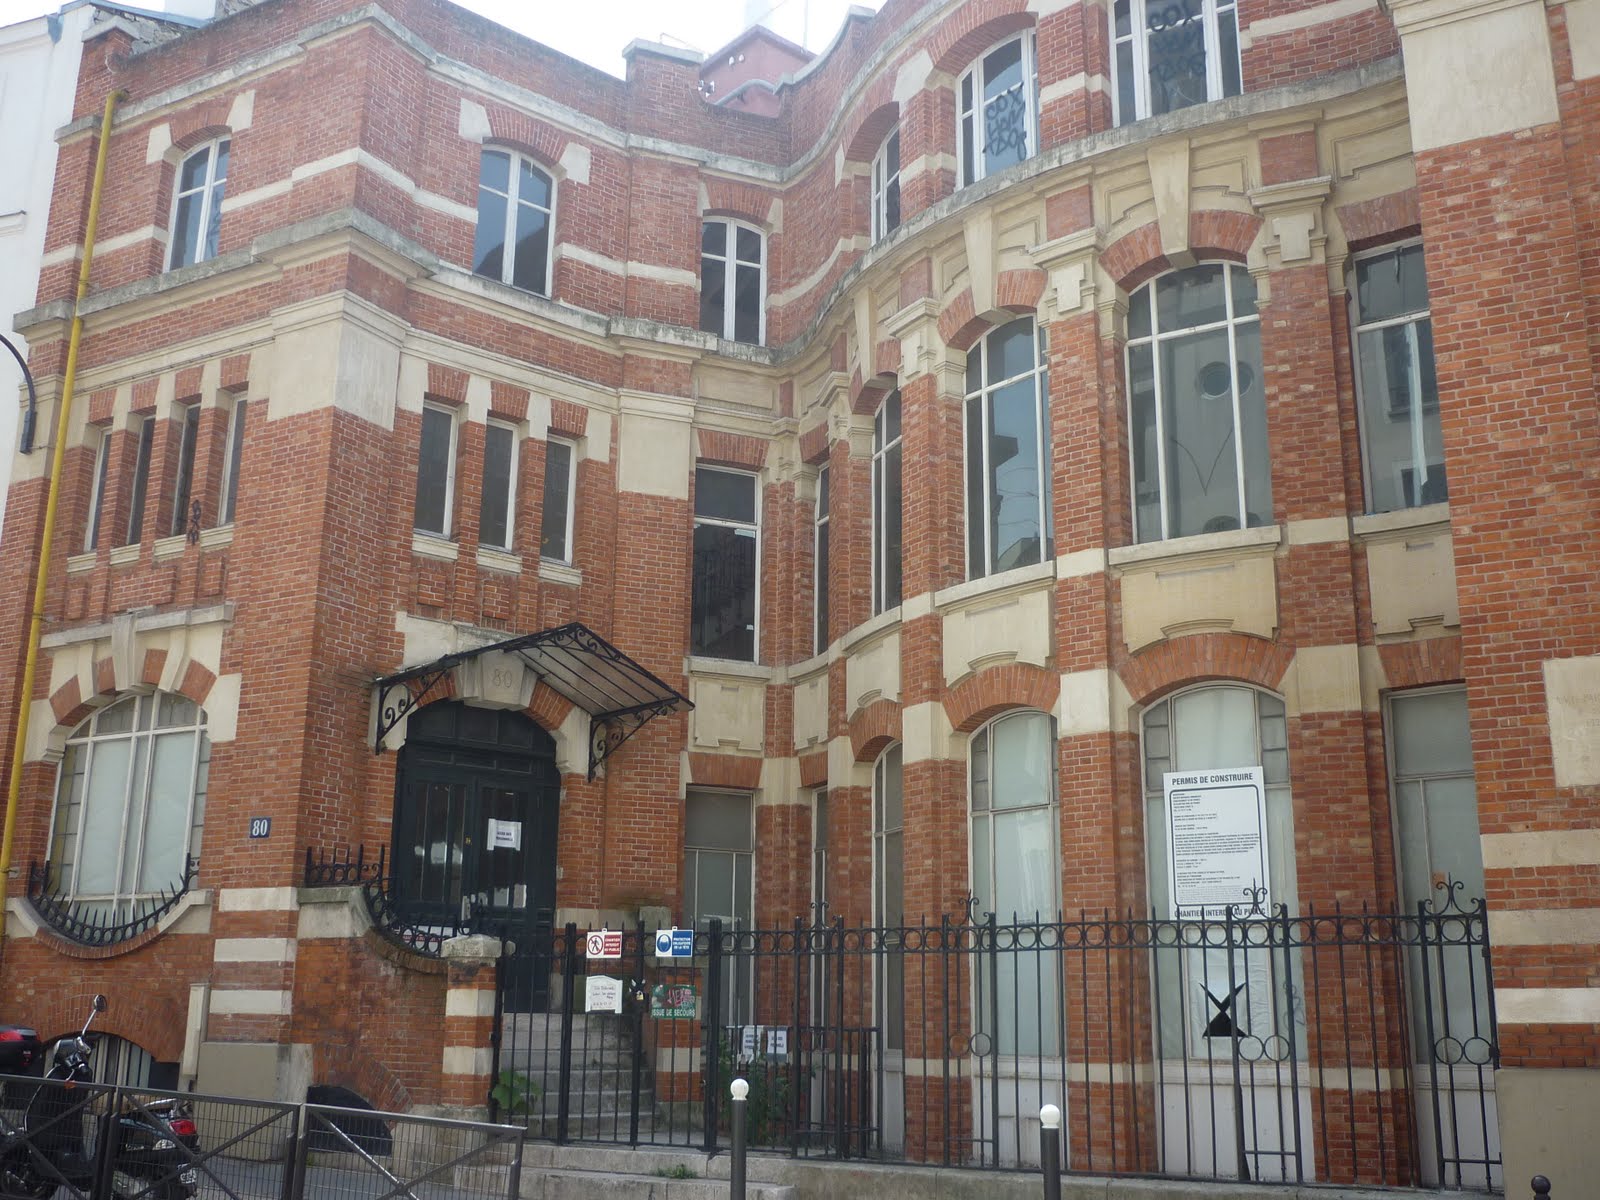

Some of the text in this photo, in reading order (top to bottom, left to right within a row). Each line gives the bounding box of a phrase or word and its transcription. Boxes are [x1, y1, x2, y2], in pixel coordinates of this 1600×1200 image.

[493, 668, 512, 688] 80
[1172, 776, 1198, 785] PERMIS
[1210, 772, 1253, 783] CONSTRUIRE
[252, 819, 268, 836] 80
[1174, 909, 1204, 917] CHANTIE
[652, 1008, 696, 1018] ISSUE DE SECOURS
